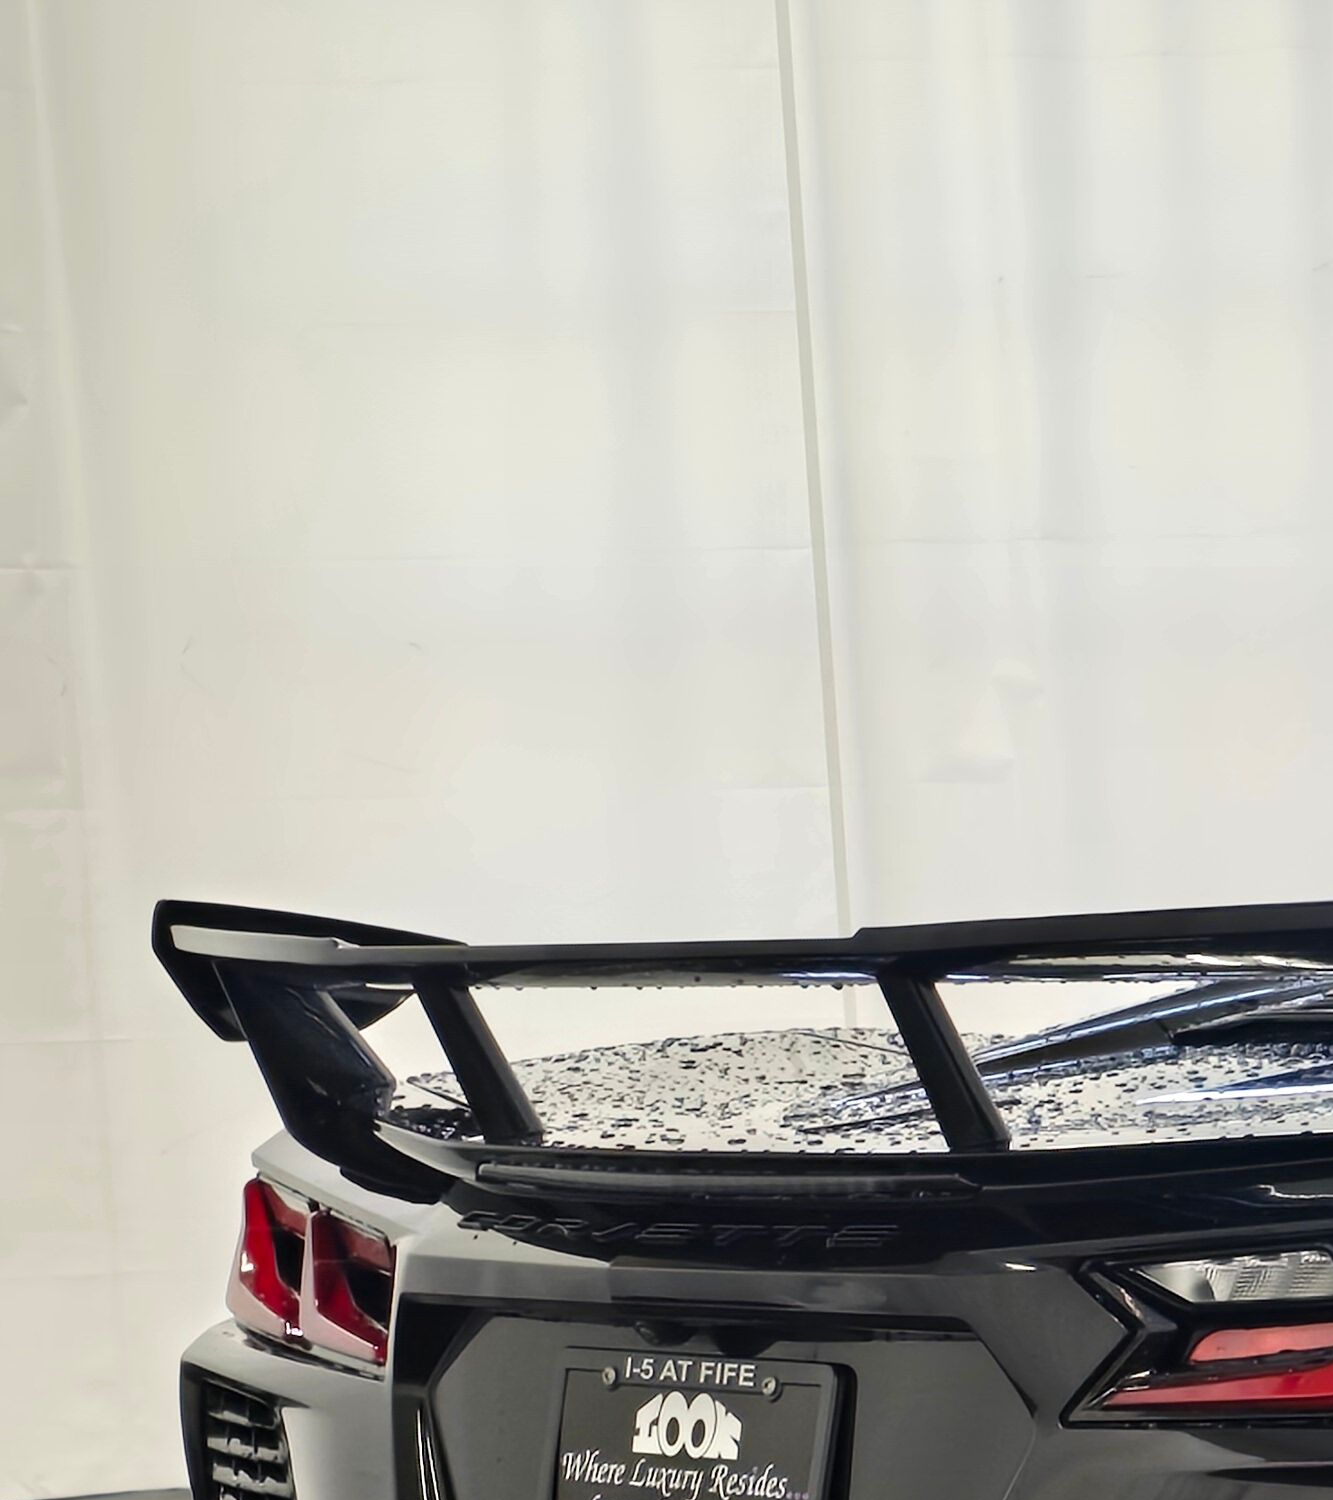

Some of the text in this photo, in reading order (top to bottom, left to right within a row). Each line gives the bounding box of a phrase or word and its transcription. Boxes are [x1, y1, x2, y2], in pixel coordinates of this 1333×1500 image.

[456, 1210, 899, 1249] CORVETTE
[625, 1356, 756, 1387] I-5 AT FIFE
[562, 1449, 626, 1485] Where
[709, 1463, 809, 1500] Resides...
